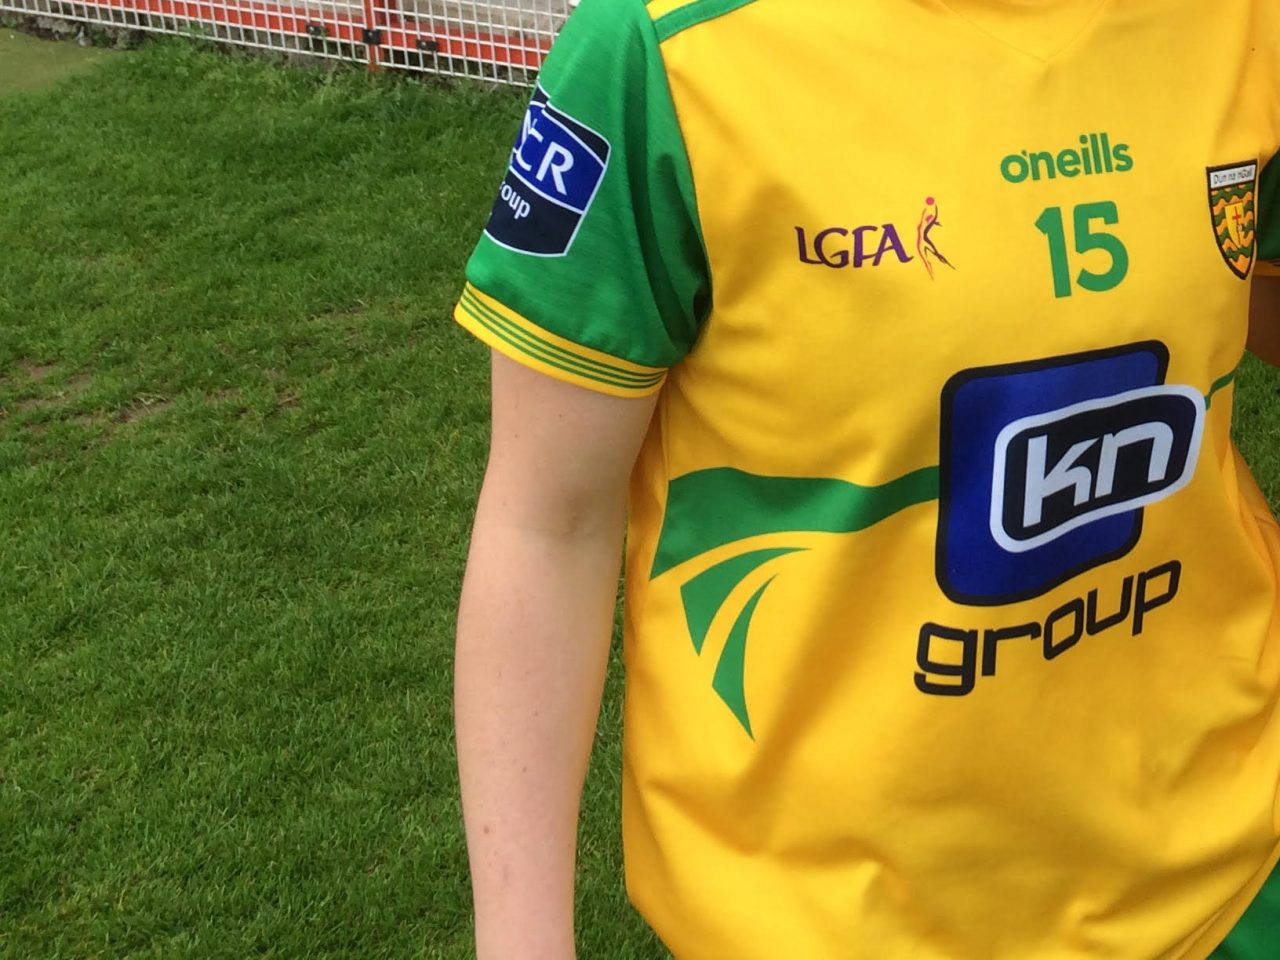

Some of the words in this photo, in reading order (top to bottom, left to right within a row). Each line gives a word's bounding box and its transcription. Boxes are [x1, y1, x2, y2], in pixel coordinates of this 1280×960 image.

[499, 181, 531, 220] oup
[794, 223, 915, 269] LGFA
[1034, 200, 1130, 299] 15
[1022, 420, 1175, 528] kn
[914, 559, 1182, 697] group
